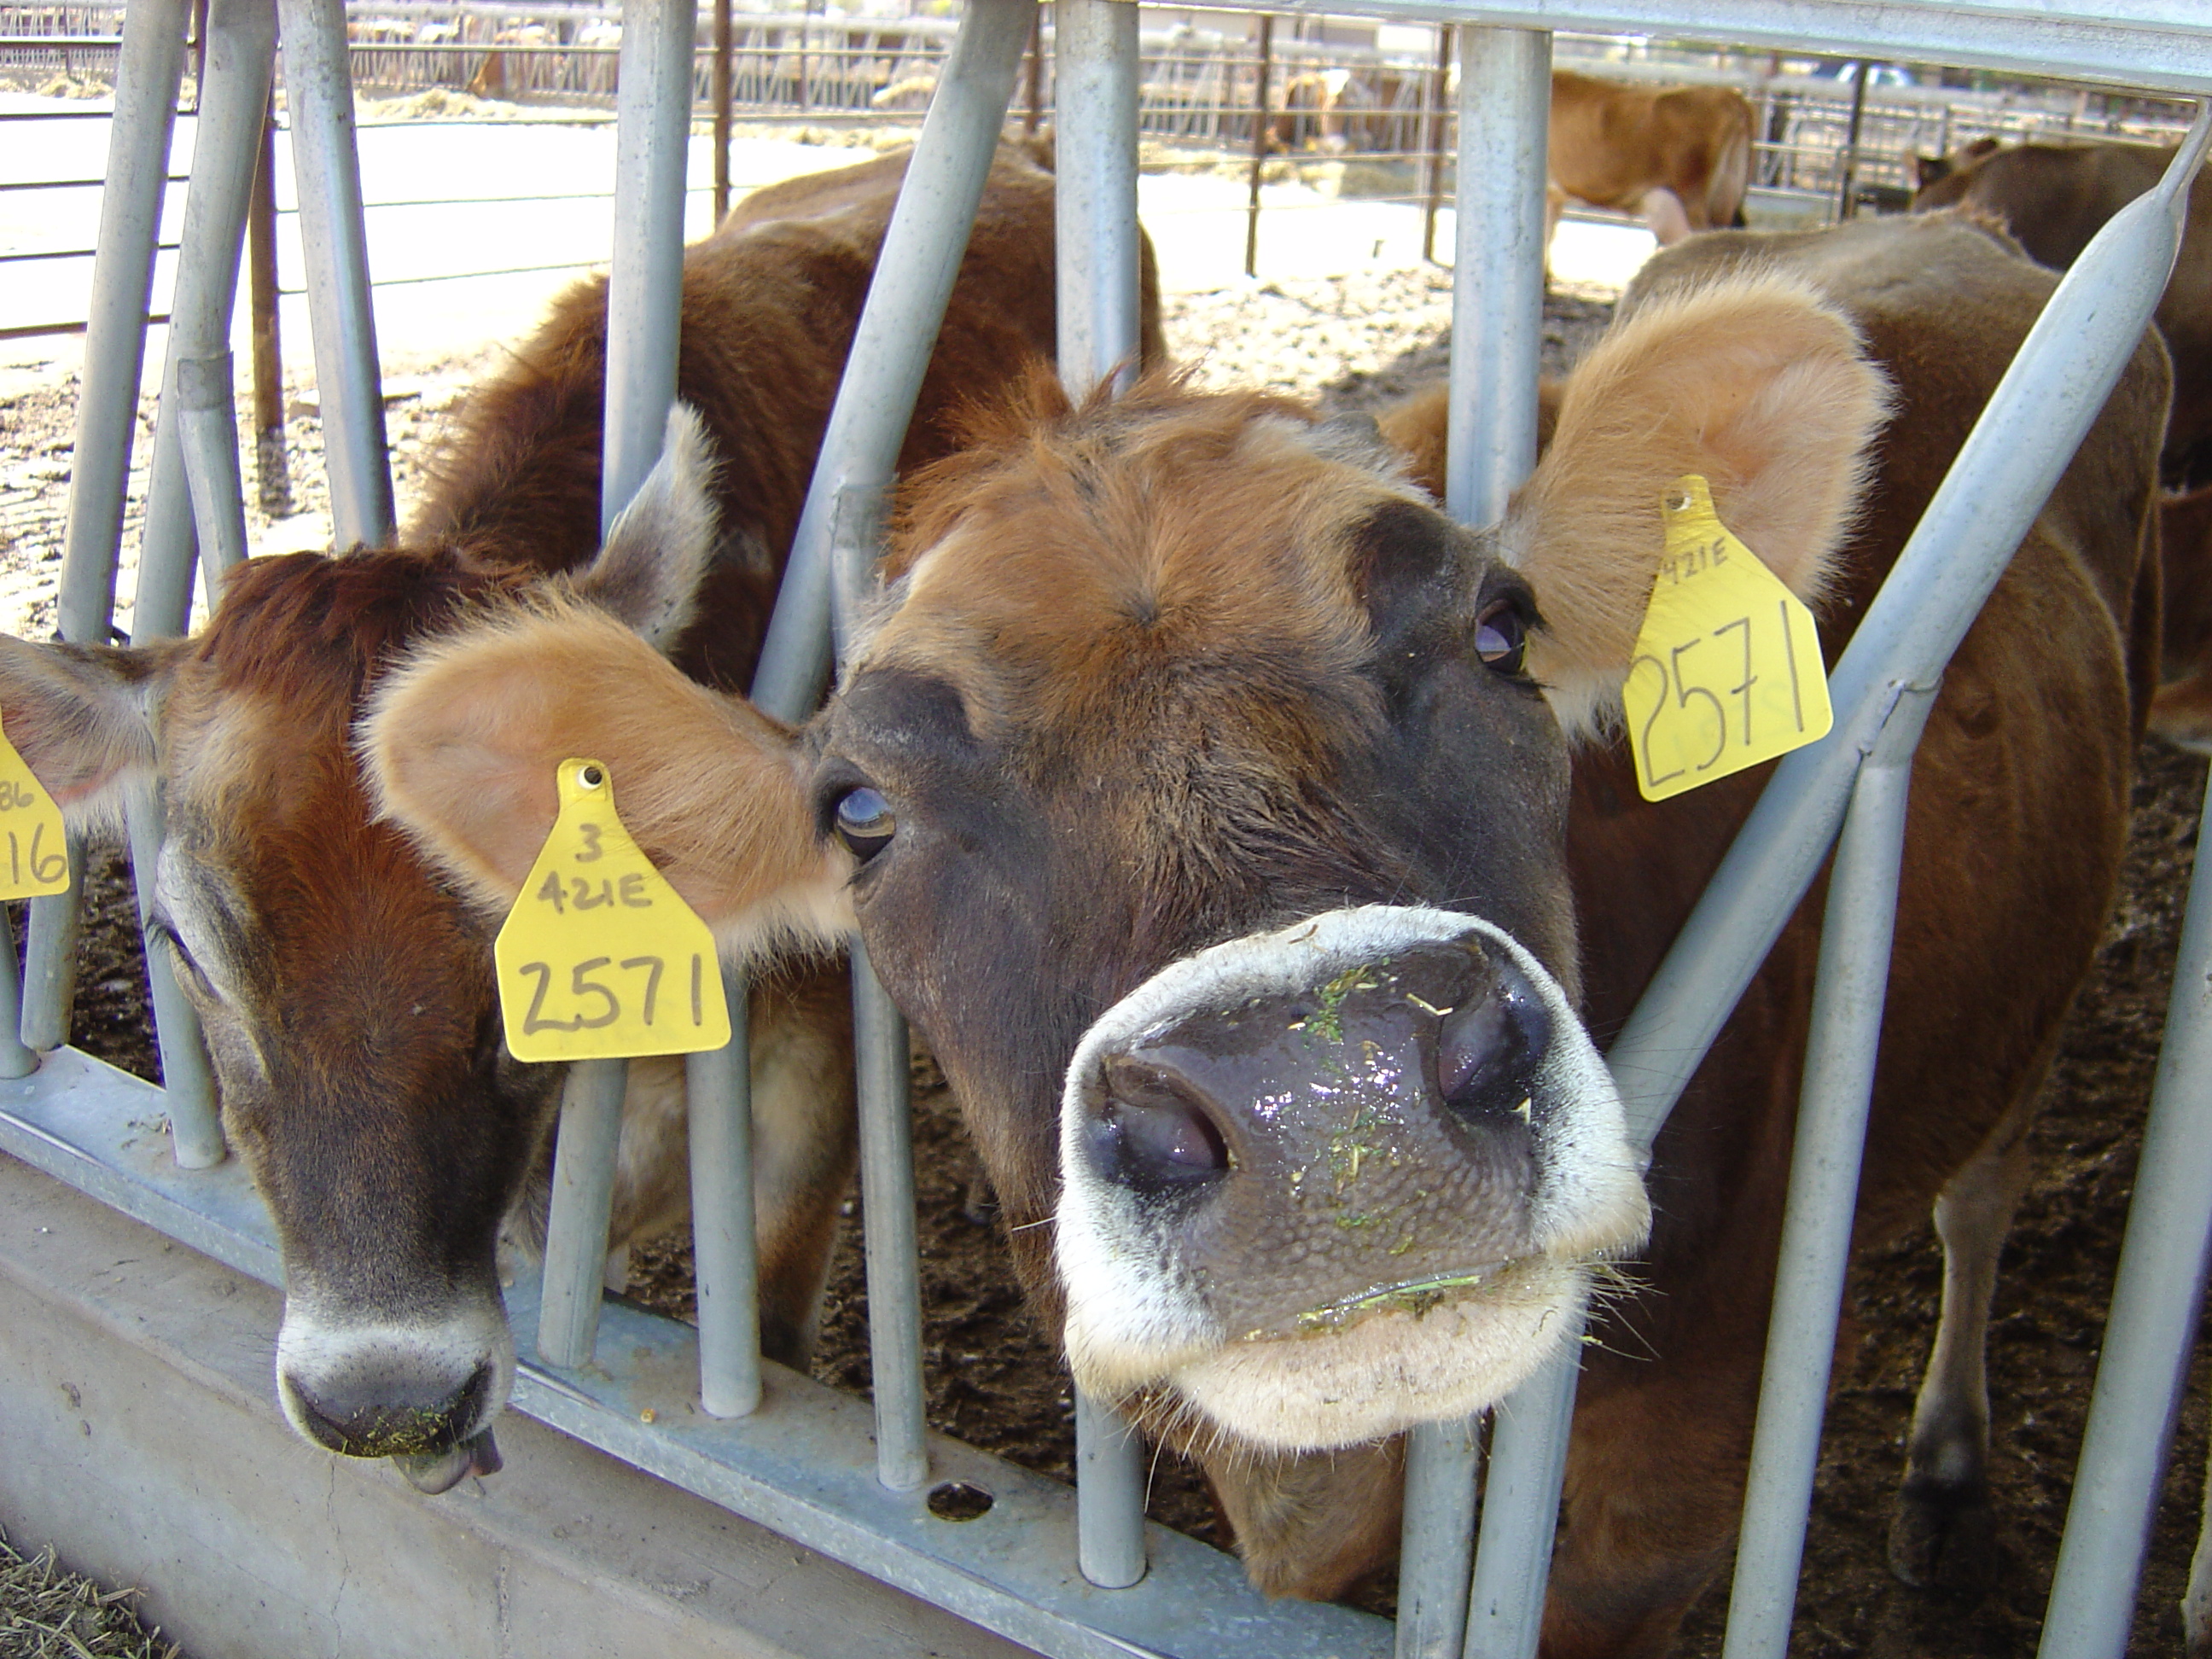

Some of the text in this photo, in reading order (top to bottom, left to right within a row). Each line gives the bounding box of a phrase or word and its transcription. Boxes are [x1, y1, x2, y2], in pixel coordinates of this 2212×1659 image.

[1662, 536, 1728, 585] 421E
[1631, 599, 1804, 787] 2571
[573, 823, 602, 863] 3
[538, 870, 653, 915] 421E
[519, 952, 702, 1036] 2571
